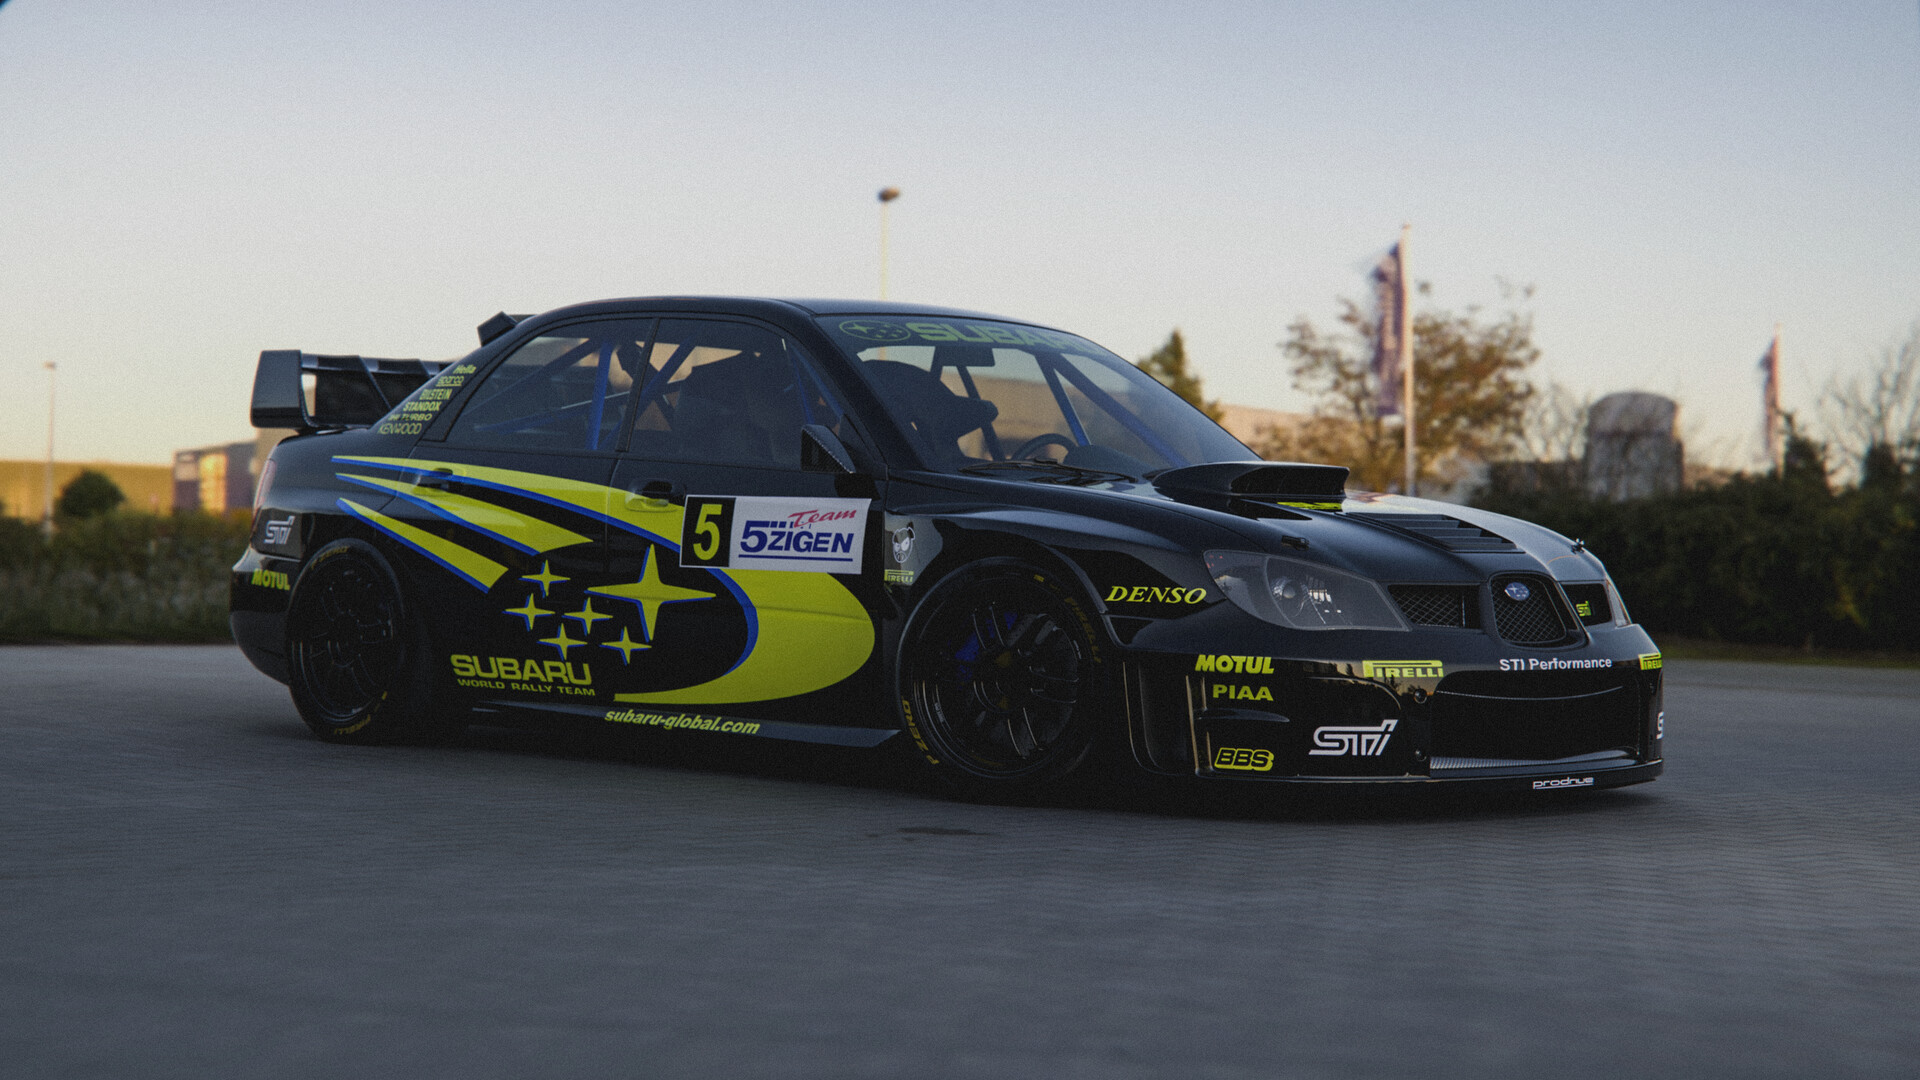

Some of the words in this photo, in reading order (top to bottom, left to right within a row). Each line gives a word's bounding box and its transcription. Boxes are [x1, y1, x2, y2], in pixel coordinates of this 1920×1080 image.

[419, 388, 452, 400] BILSTEIN
[402, 401, 442, 412] STANDOX
[378, 423, 422, 435] KENWOOD
[788, 509, 857, 528] Team
[693, 504, 723, 561] 5
[251, 569, 290, 591] MOTUL
[884, 569, 915, 582] PIRELLI
[1105, 585, 1207, 605] DENSO
[451, 654, 592, 685] SUBARU
[1195, 654, 1275, 675] MOTUL
[1362, 660, 1444, 678] PIRELLI
[1500, 658, 1525, 671] STI
[1529, 657, 1613, 671] Performance
[457, 678, 506, 690] WORLD
[511, 683, 552, 694] RALLY
[557, 686, 595, 696] TEAM
[1212, 684, 1274, 701] PIAA
[604, 709, 761, 735] subaru-global.com
[1214, 748, 1275, 771] BBS
